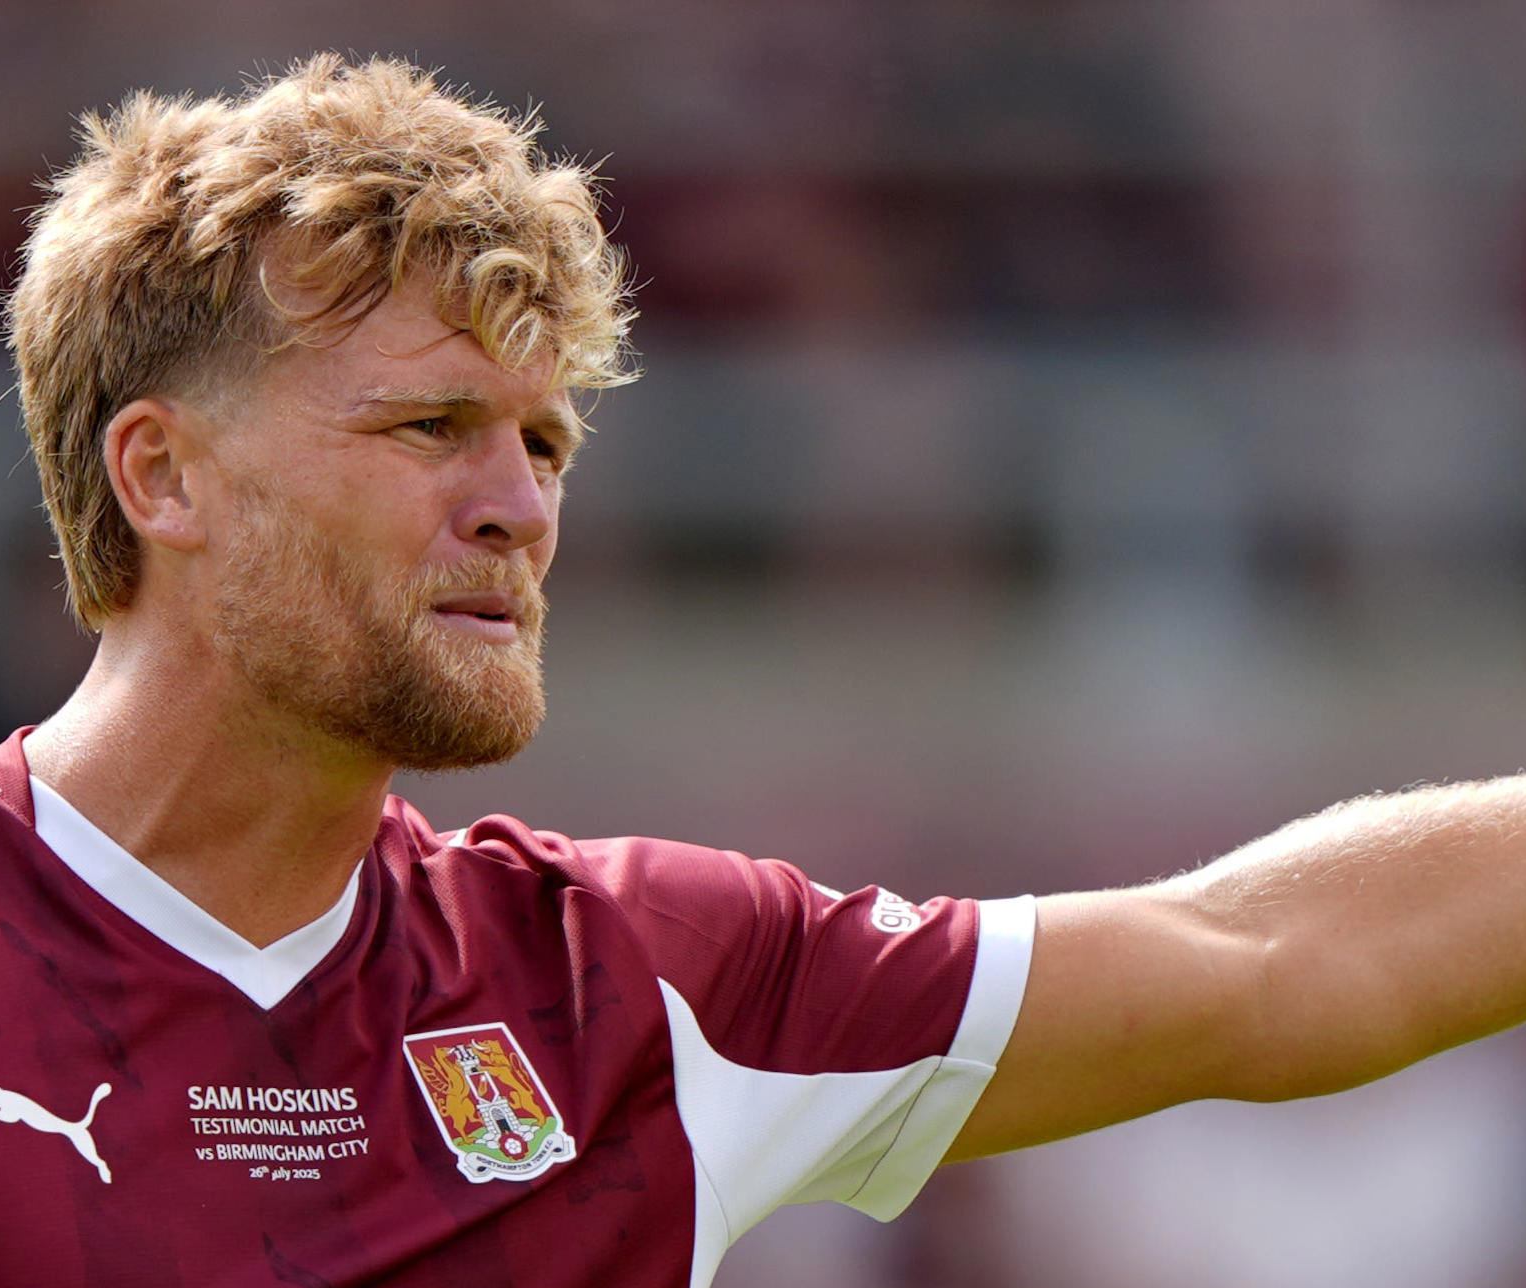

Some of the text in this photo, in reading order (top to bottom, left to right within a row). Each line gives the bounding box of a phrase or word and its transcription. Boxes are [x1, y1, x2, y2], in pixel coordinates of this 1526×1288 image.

[187, 1086, 358, 1113] SAM HOSKINS
[190, 1115, 366, 1136] TESTIMONIAL MATCH
[195, 1138, 369, 1162] vs BIRMINGHAM CITY
[249, 1165, 270, 1178] 26th
[292, 1168, 321, 1180] 2025
